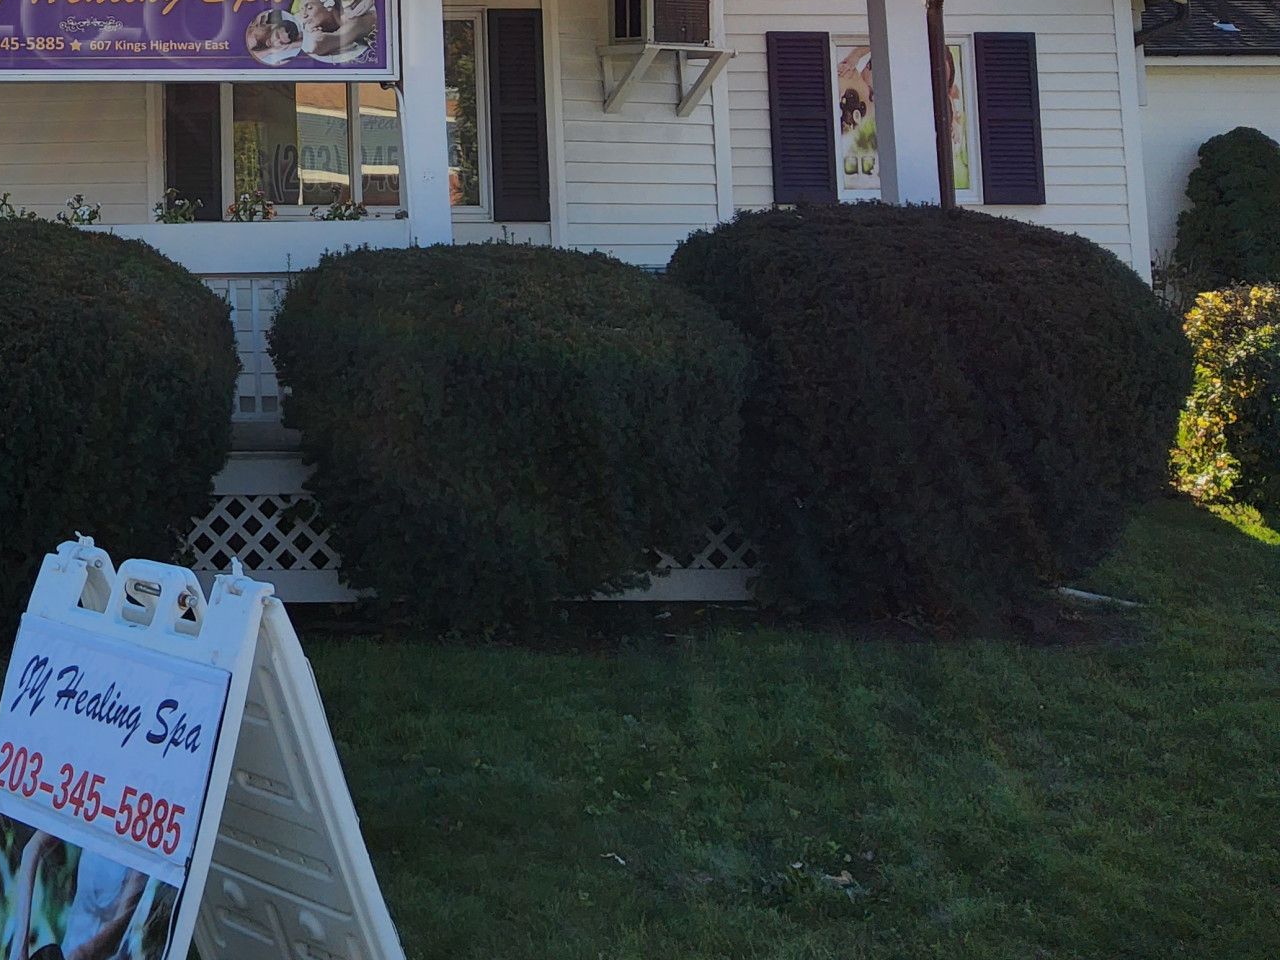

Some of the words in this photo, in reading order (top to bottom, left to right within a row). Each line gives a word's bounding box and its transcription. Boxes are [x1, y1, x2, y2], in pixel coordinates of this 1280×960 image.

[89, 40, 111, 52] 607
[115, 39, 148, 55] Kings
[150, 39, 202, 55] Highway
[205, 39, 230, 52] East
[10, 654, 53, 717] JY
[54, 664, 143, 747] Healing
[146, 698, 203, 759] Spa
